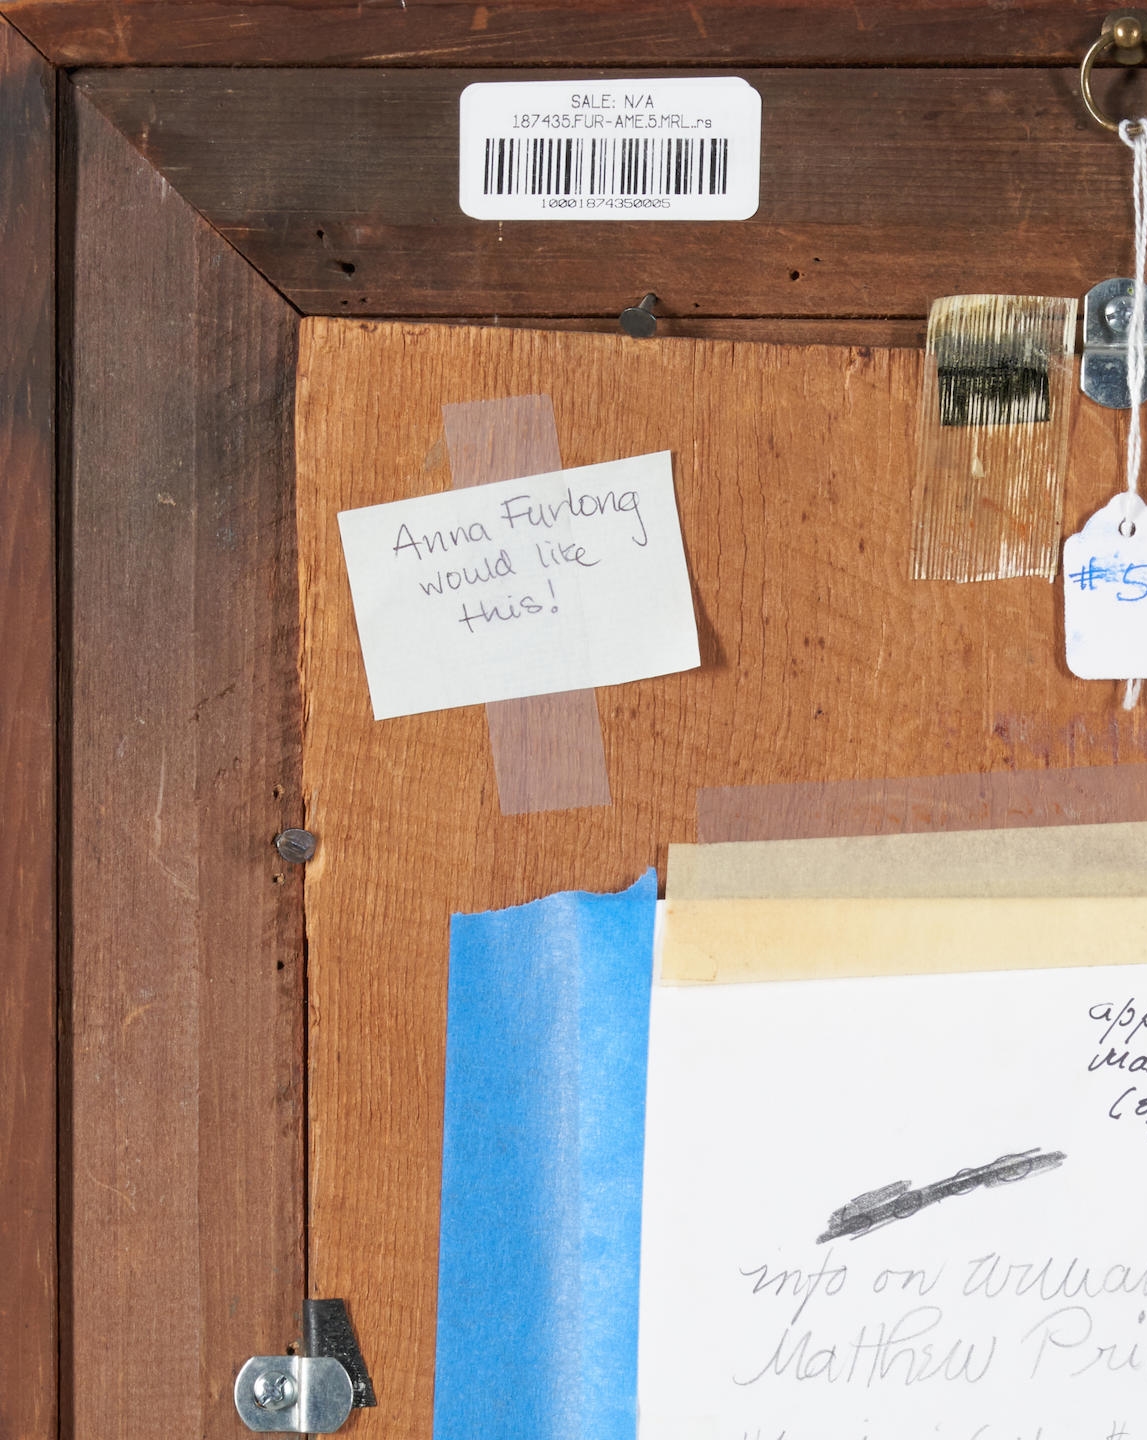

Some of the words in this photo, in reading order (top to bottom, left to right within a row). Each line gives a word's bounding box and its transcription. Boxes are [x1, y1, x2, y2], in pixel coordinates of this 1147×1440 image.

[570, 94, 616, 109] SALE:
[623, 94, 654, 109] N/A
[541, 198, 671, 209] 10001874350005
[392, 523, 492, 561] Anna
[500, 487, 649, 548] Furlong
[419, 549, 517, 597] would
[536, 540, 601, 568] like
[457, 578, 560, 634] this!
[738, 1246, 848, 1327] info
[872, 1261, 946, 1297] on
[731, 1306, 998, 1389] Matthew
